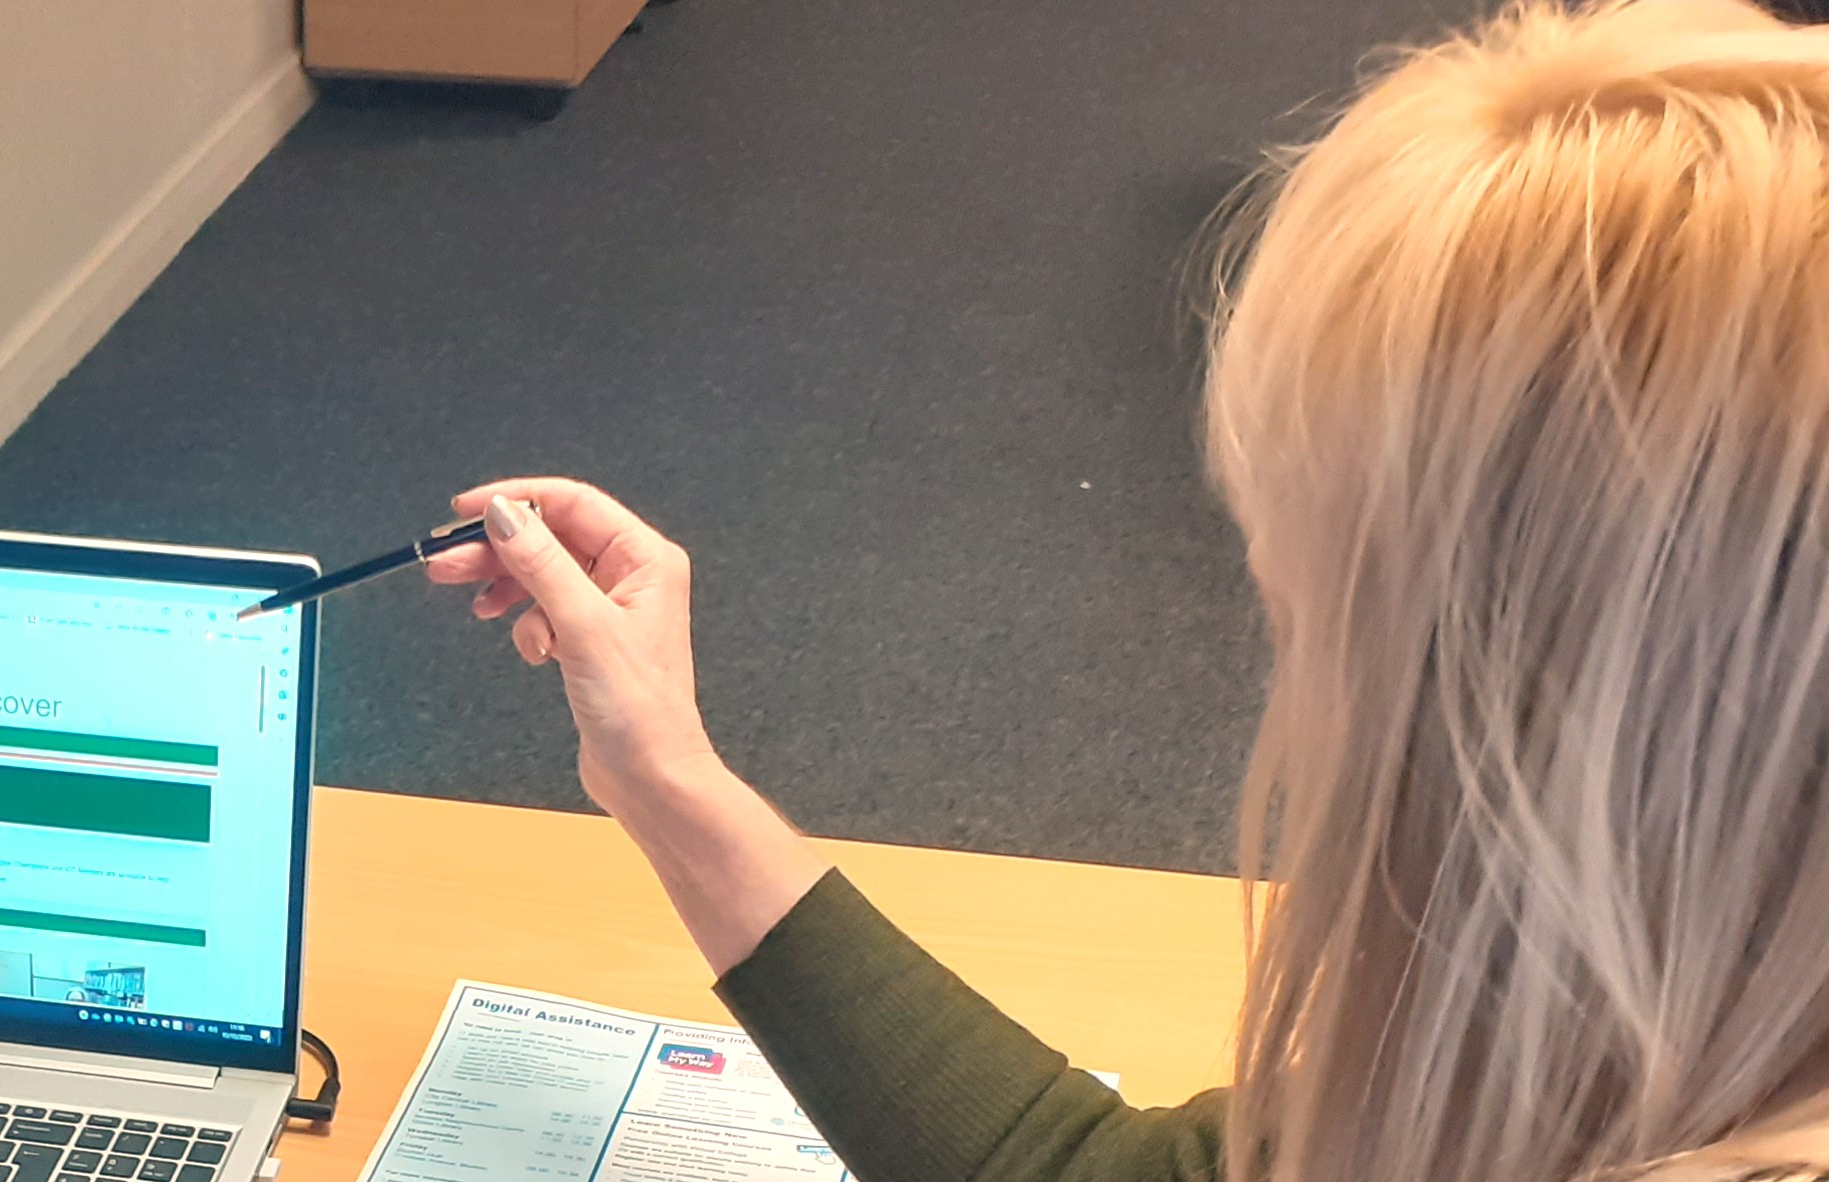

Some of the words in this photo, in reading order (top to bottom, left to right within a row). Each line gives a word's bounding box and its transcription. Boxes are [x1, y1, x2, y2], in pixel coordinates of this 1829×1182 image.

[472, 998, 531, 1017] Digital
[535, 1010, 637, 1036] Assistance
[663, 1028, 726, 1043] Providing
[729, 1037, 755, 1046] Info
[667, 1055, 686, 1066] My
[687, 1058, 715, 1069] Way
[670, 1049, 706, 1060] Learn
